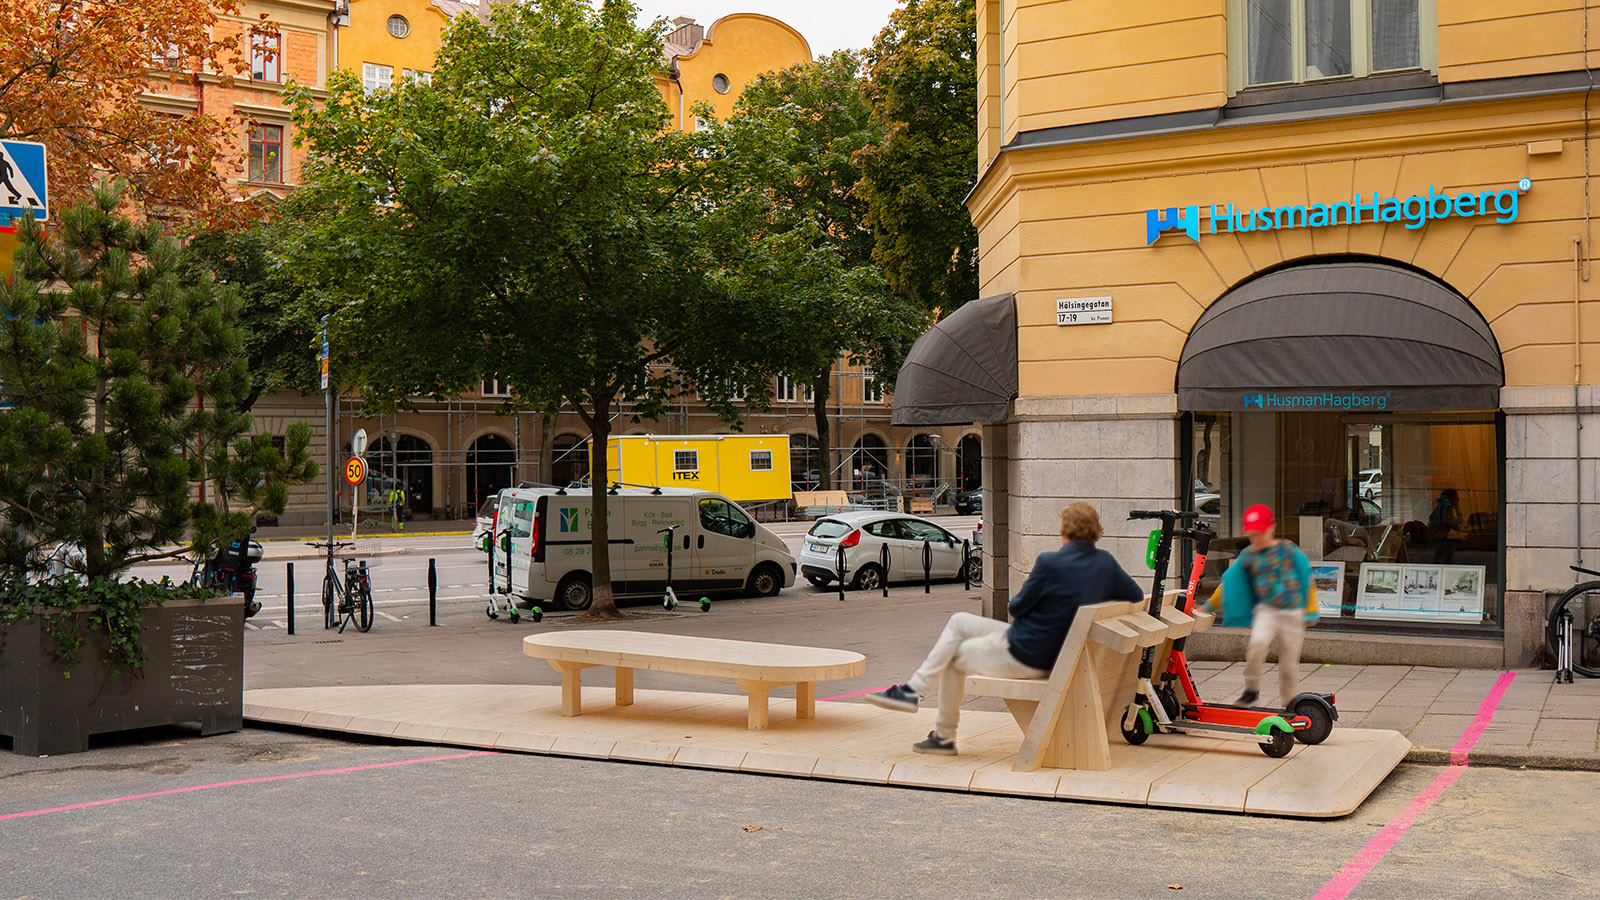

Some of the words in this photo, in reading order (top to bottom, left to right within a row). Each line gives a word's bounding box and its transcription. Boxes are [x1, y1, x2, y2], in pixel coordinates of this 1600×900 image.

[1210, 184, 1519, 234] HusmanHagberg
[1058, 300, 1110, 311] Hälsingegatan
[1058, 313, 1077, 323] 17-19
[1266, 392, 1387, 410] HusmanHagberg
[348, 464, 361, 478] 50
[672, 471, 699, 480] ITEX
